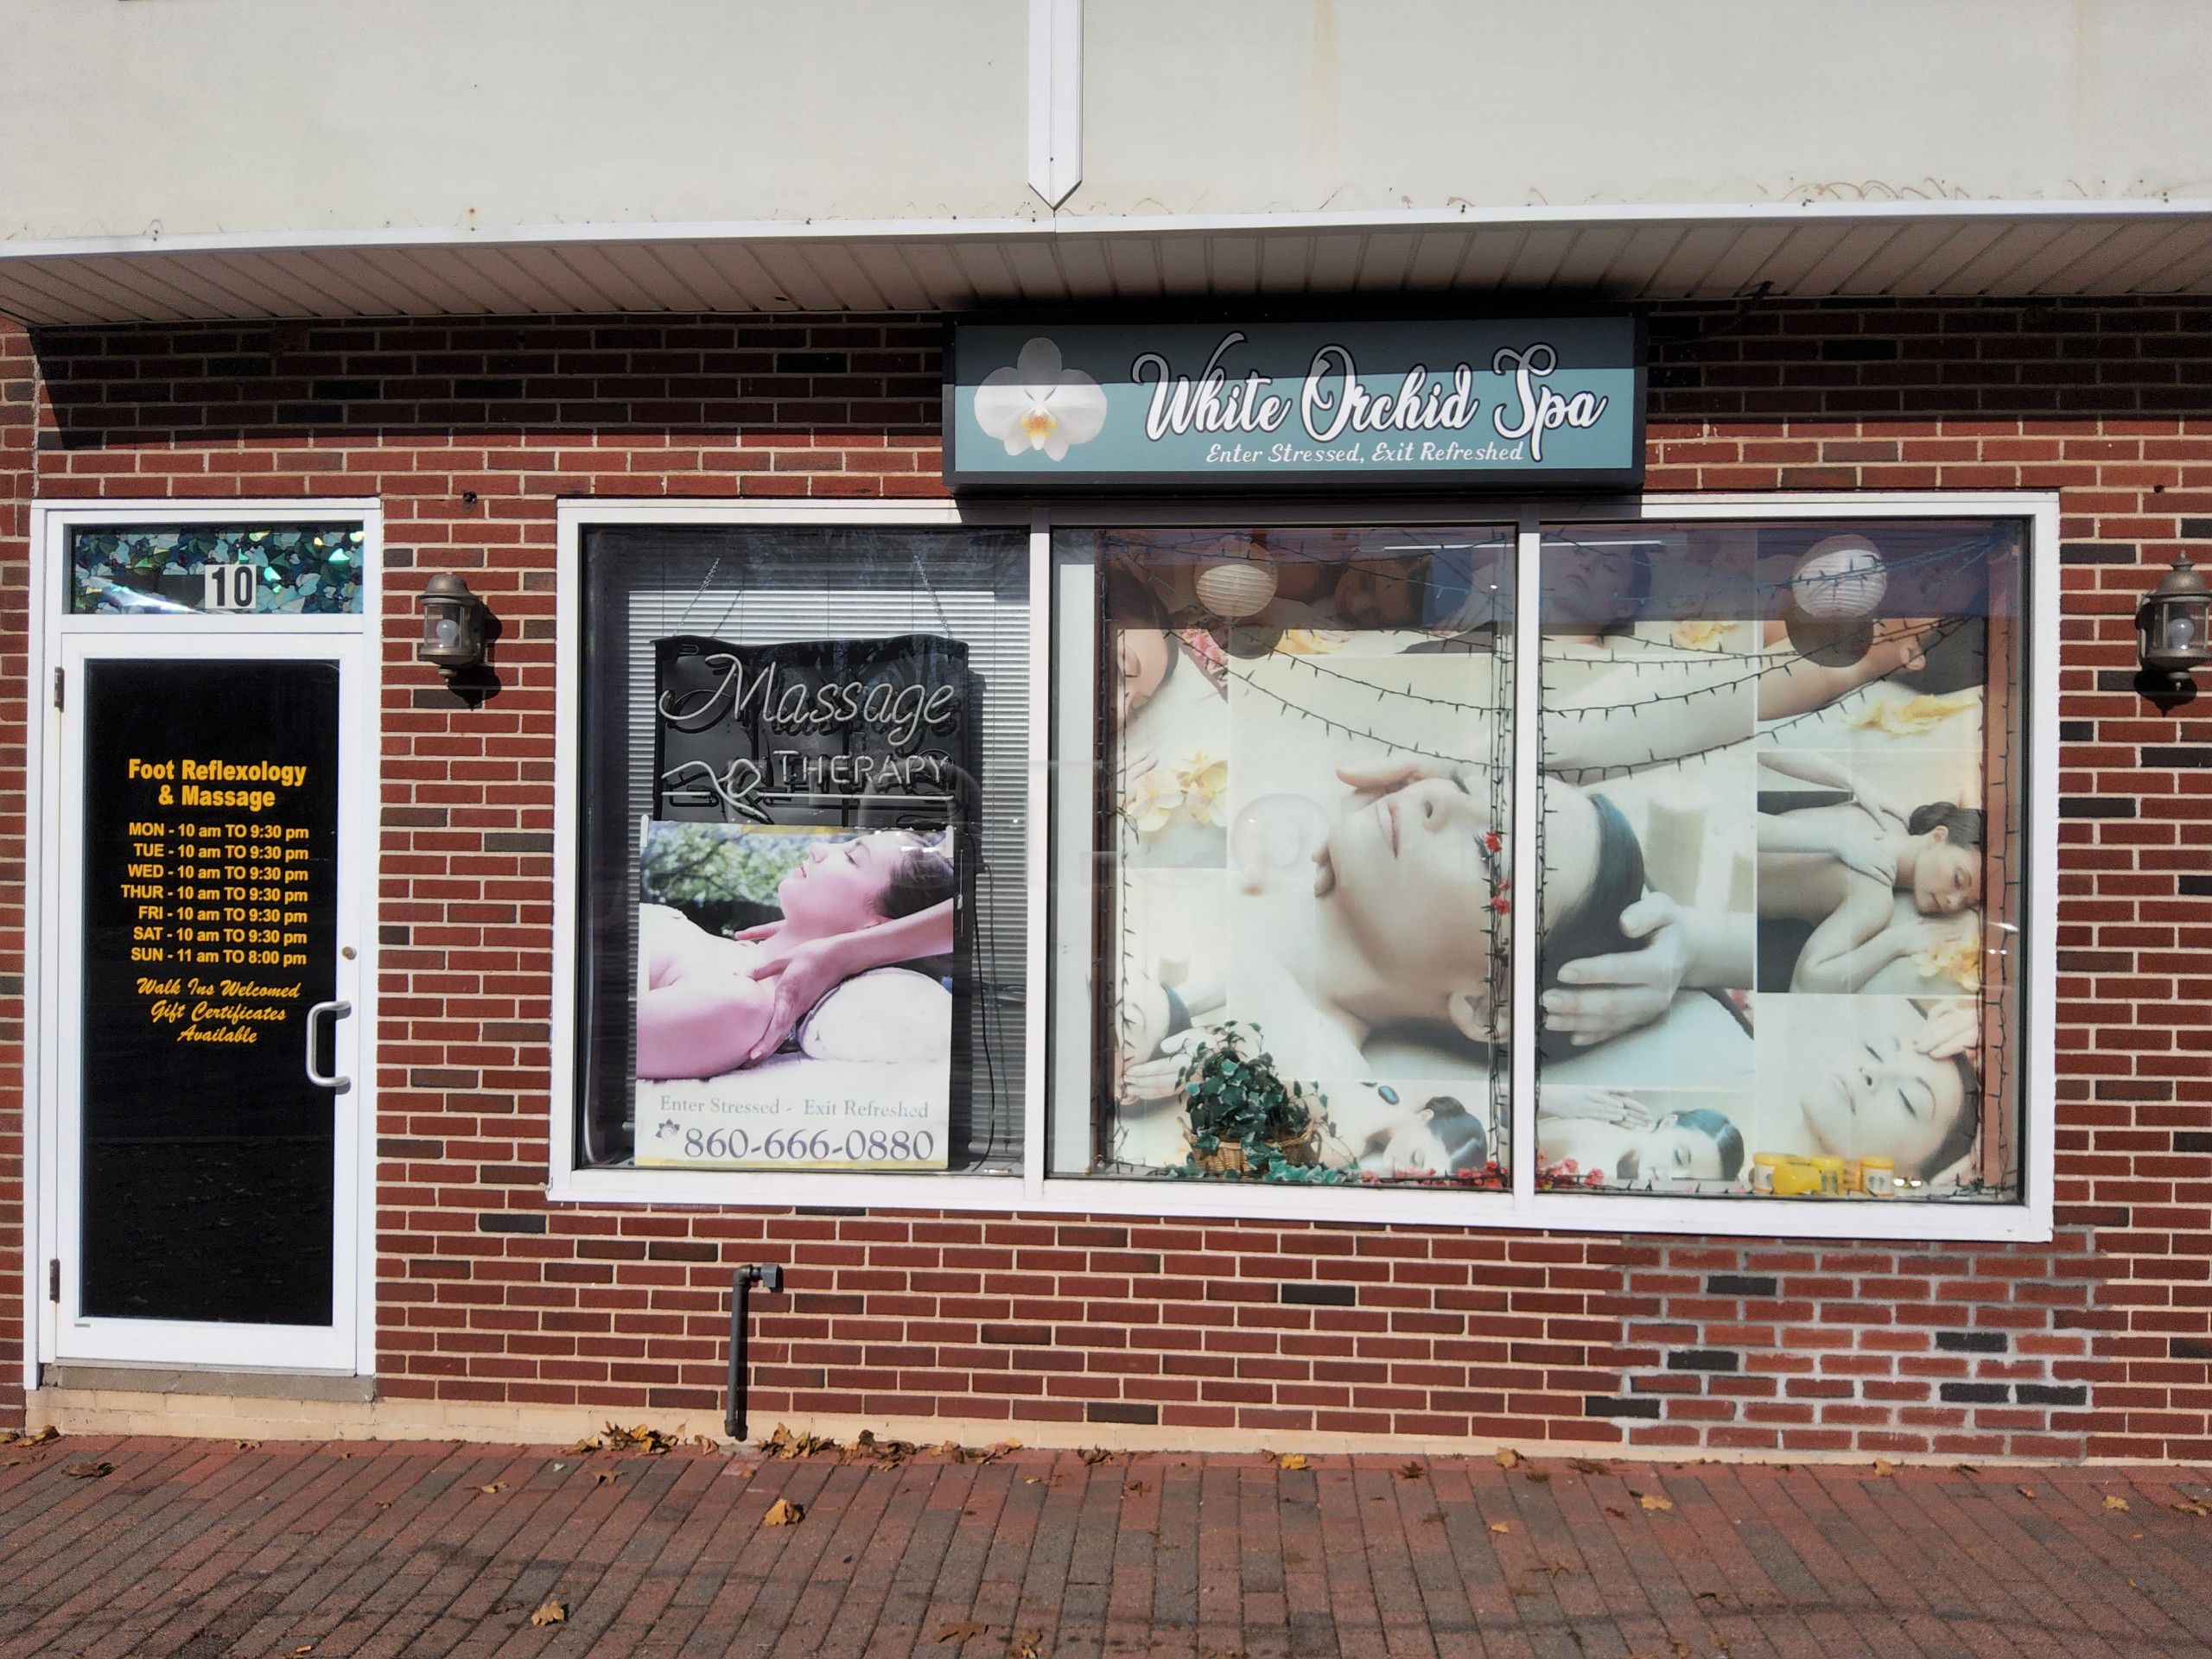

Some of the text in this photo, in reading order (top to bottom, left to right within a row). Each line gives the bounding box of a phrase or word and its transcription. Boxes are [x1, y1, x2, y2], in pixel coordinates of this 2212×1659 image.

[1130, 331, 1609, 462] White Orchid Spa
[1206, 442, 1524, 464] Enter Stressed, Exit Refreshed
[211, 566, 253, 607] 10
[658, 652, 955, 747] Massage
[129, 759, 307, 789] Foot Reflexology
[772, 749, 950, 785] THERAPY
[158, 785, 275, 811] & Massage
[130, 823, 164, 836] MON
[179, 823, 195, 837] 10
[199, 827, 221, 837] am
[226, 824, 246, 837] TO
[251, 824, 282, 838] 9:30
[286, 829, 308, 842] pm
[134, 843, 163, 857] TUE
[178, 844, 194, 857] 10
[198, 848, 220, 858] am
[225, 845, 246, 859] TO
[250, 846, 281, 859] 9:30
[285, 849, 308, 862] pm
[128, 864, 163, 878] WED
[178, 866, 194, 879] 10
[198, 868, 220, 879] am
[225, 866, 245, 880] TO
[250, 867, 281, 880] 9:30
[285, 870, 308, 883] pm
[121, 885, 163, 899] THUR
[177, 887, 194, 899] 10
[198, 889, 219, 899] am
[224, 887, 245, 900] TO
[250, 887, 281, 901] 9:30
[285, 892, 308, 905] pm
[139, 906, 162, 919] FRI
[177, 907, 194, 920] 10
[197, 910, 219, 920] am
[224, 908, 245, 921] TO
[249, 908, 280, 922] 9:30
[284, 912, 307, 925] pm
[134, 926, 163, 940] SAT
[176, 928, 193, 941] 10
[197, 931, 219, 941] am
[223, 929, 245, 942] TO
[249, 930, 280, 943] 9:30
[283, 933, 307, 946] pm
[131, 947, 163, 961] SUN
[177, 949, 191, 962] 11
[196, 952, 219, 963] am
[223, 950, 245, 963] TO
[249, 950, 279, 964] 8:00
[283, 954, 306, 968] pm
[137, 977, 301, 998] Walk Ins Welcomed
[151, 1000, 286, 1027] Gift Certificates
[178, 1023, 257, 1043] Available
[660, 1095, 705, 1112] Enter
[710, 1096, 779, 1115] Stressed
[804, 1099, 836, 1116] Exit
[844, 1100, 929, 1118] Refreshed
[684, 1128, 934, 1160] 860-666-0880
